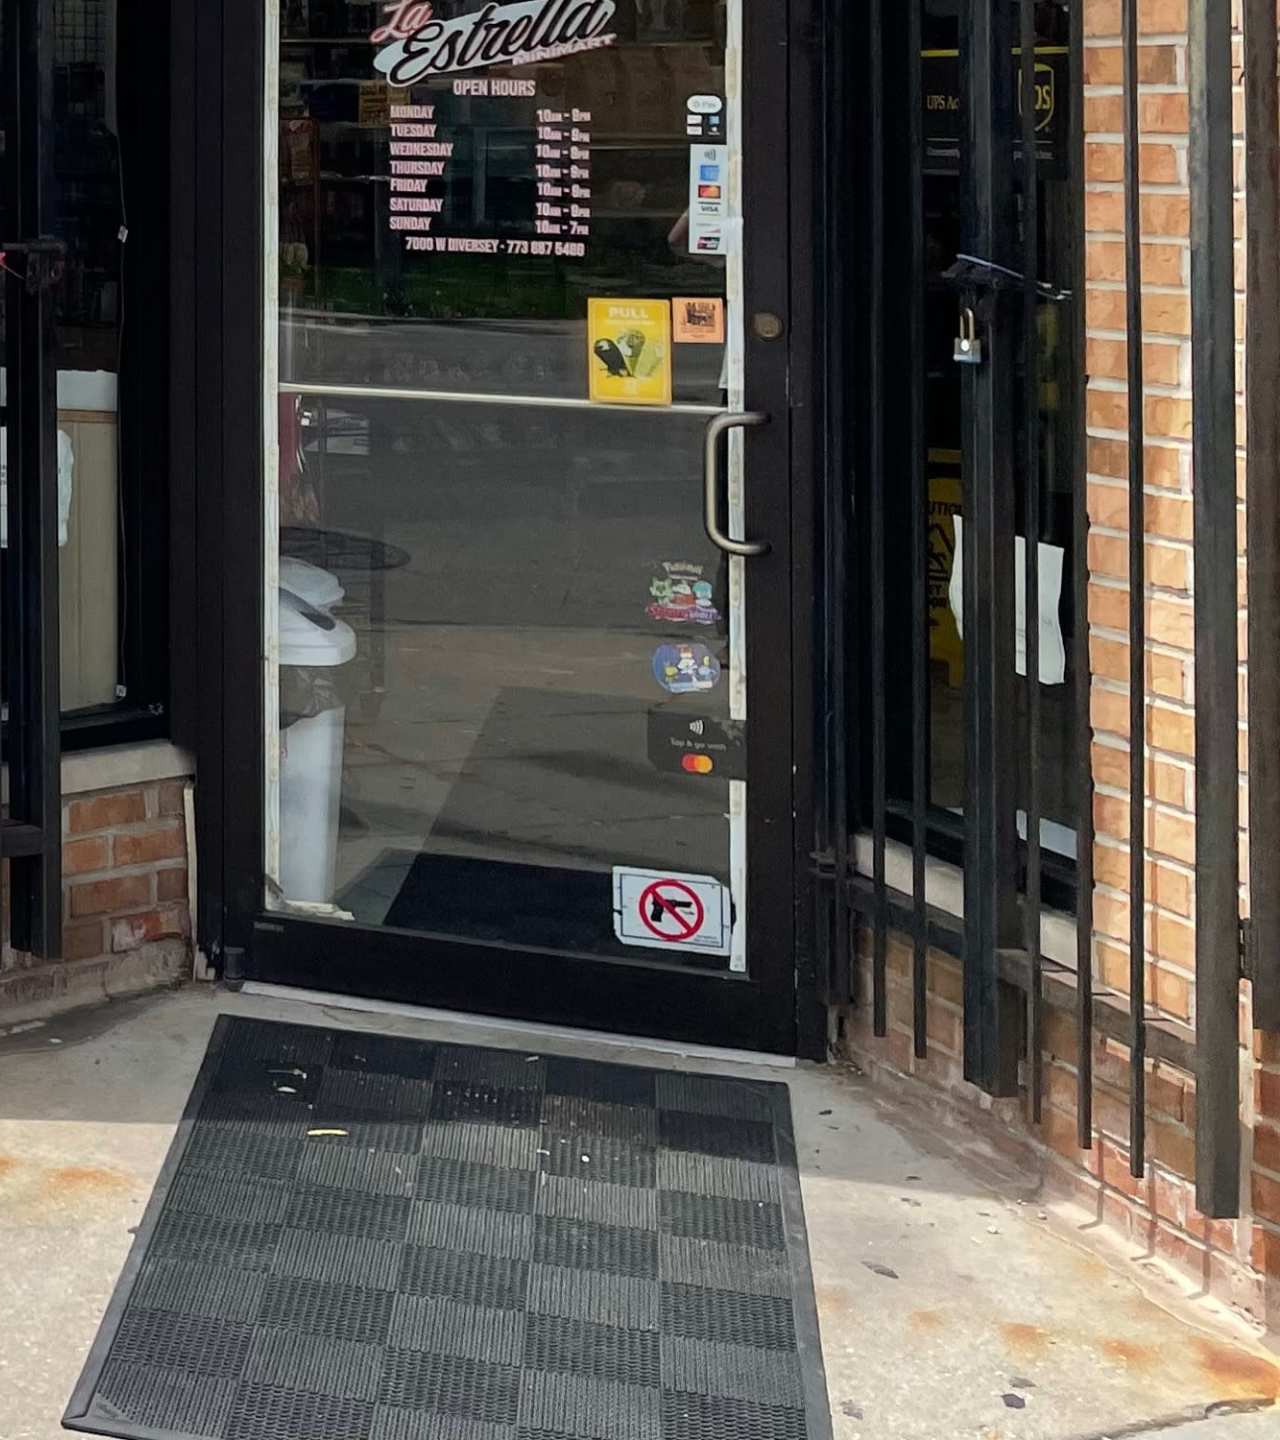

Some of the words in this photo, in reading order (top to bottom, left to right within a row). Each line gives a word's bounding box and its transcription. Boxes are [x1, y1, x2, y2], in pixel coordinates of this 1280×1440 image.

[452, 79, 488, 96] OPEN
[491, 79, 536, 97] HOURS
[389, 105, 435, 119] MONDAY
[389, 123, 437, 138] TUESDAY
[389, 142, 454, 157] WEDNESDAY
[389, 161, 445, 176] THURSDAY
[389, 179, 428, 193] FRIDAY
[389, 198, 444, 212] SATURDAY
[389, 216, 432, 231] SUNDAY
[435, 237, 447, 251] W
[448, 237, 500, 254] DIVERSEY
[506, 240, 529, 255] 773
